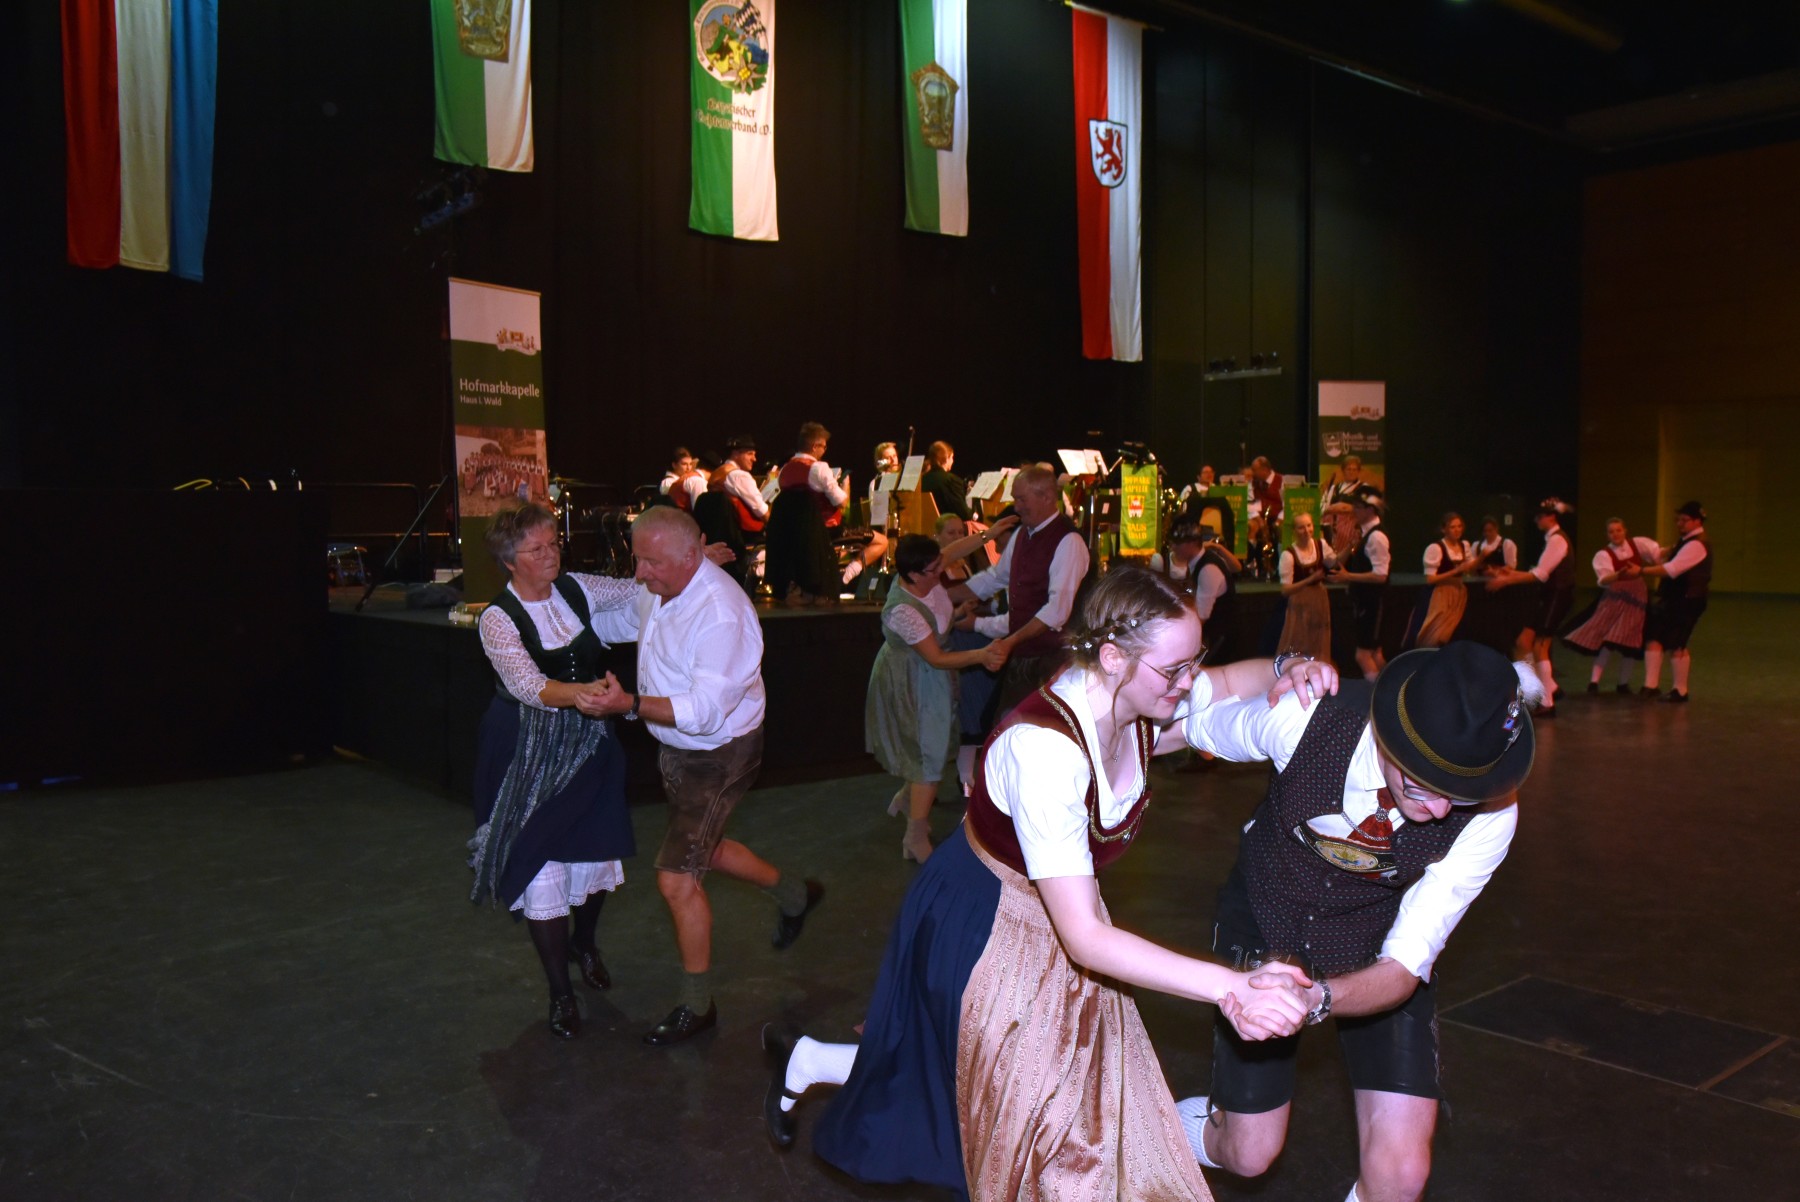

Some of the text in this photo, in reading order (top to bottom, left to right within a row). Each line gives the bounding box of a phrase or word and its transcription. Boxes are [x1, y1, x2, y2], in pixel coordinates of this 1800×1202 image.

[459, 378, 540, 399] Hofmarkkapelle
[460, 395, 478, 404] Haus
[483, 397, 502, 406] Wald
